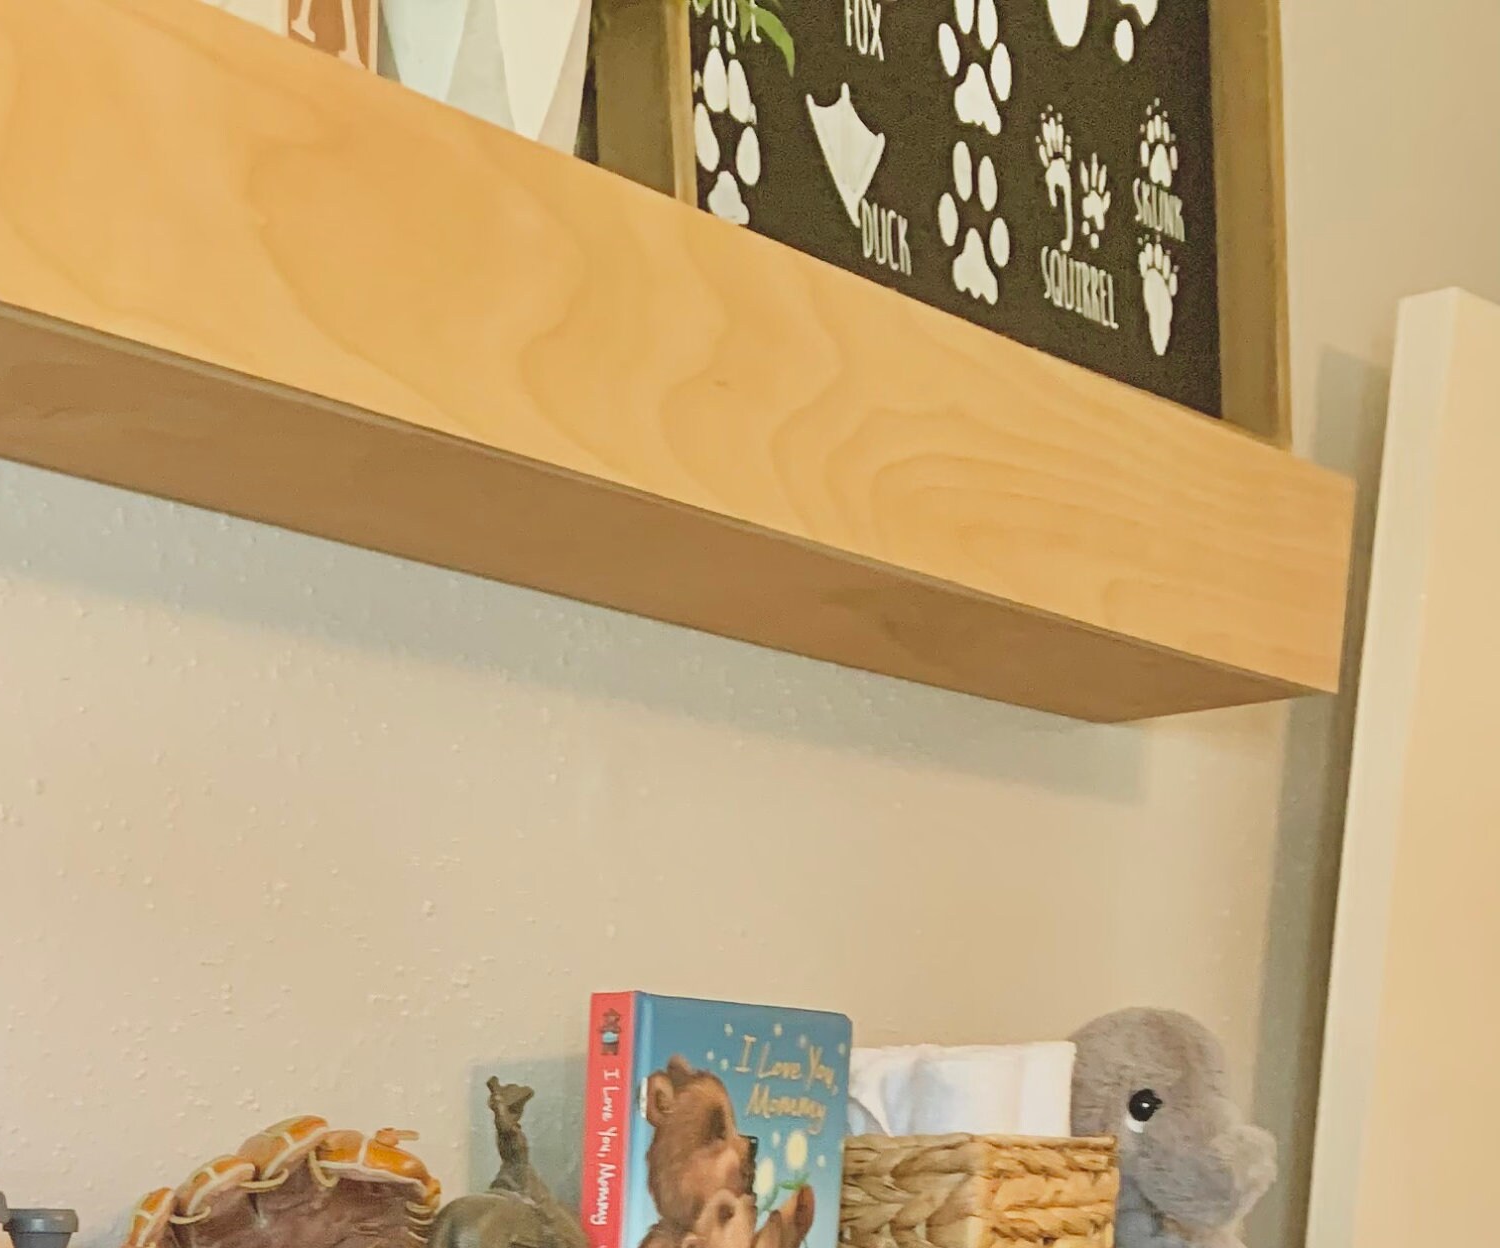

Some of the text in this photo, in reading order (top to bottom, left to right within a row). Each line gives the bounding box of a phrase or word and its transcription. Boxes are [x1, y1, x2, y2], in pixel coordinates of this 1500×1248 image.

[844, 0, 884, 61] FOX
[861, 197, 912, 276] DUCK
[1132, 177, 1185, 242] SKUNK
[1041, 246, 1119, 330] SQUIRREL
[603, 1068, 620, 1080] I
[735, 1034, 757, 1073] I
[757, 1041, 802, 1079] Love
[602, 1086, 620, 1122] Love
[746, 1083, 827, 1135] Mommy
[589, 1163, 617, 1225] Mommy
